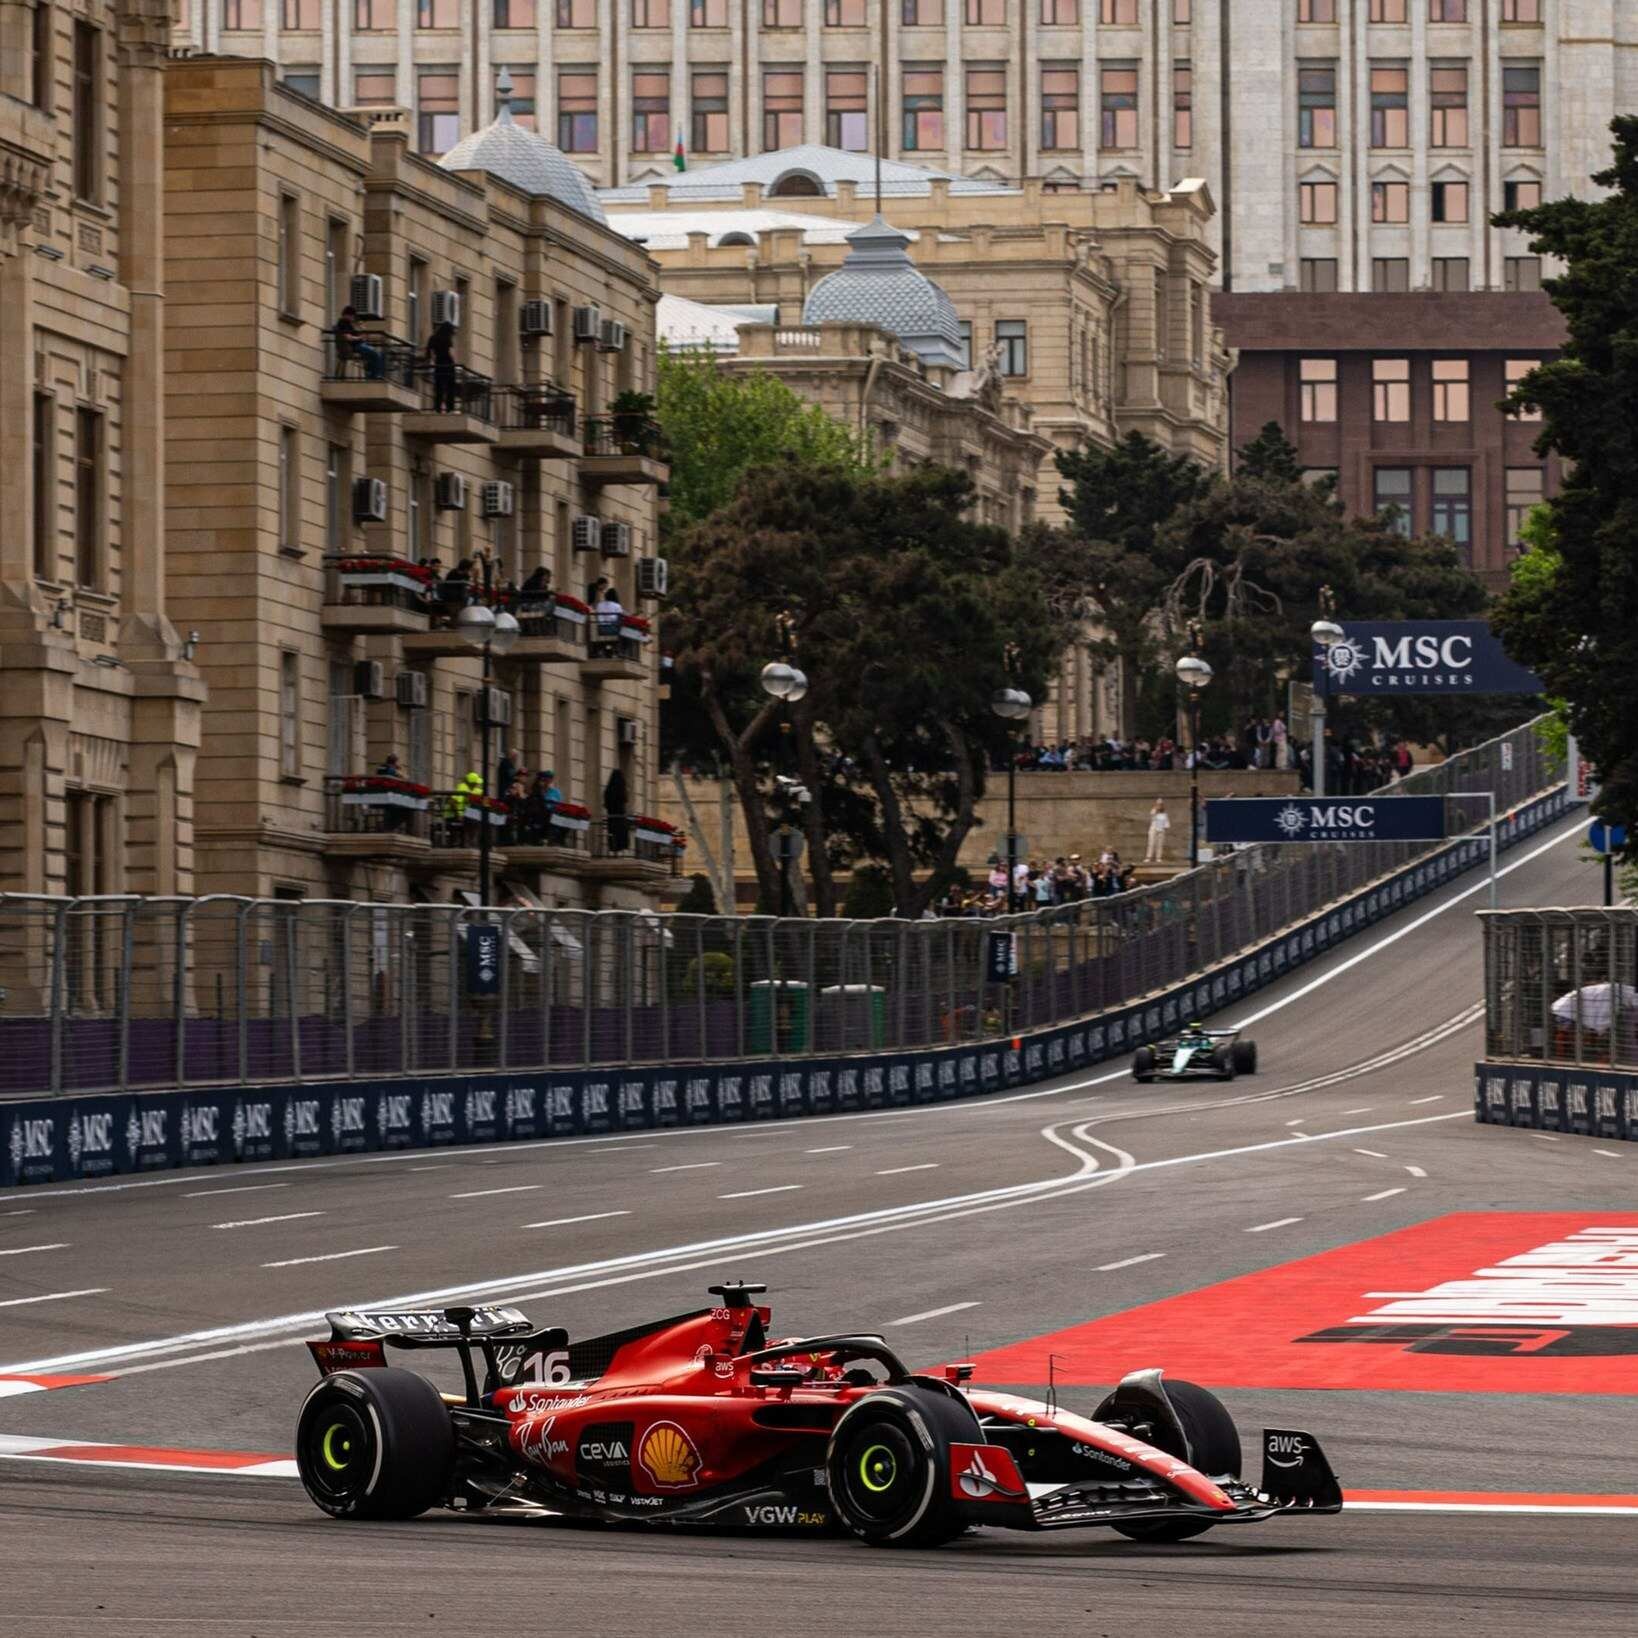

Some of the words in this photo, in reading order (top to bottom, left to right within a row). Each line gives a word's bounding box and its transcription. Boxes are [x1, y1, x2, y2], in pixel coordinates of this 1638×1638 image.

[1372, 636, 1473, 669] MSC
[1371, 675, 1474, 686] CRUISES
[1310, 806, 1375, 828] MSC
[523, 1351, 571, 1387] 16
[715, 1361, 735, 1372] aws
[527, 1394, 592, 1412] Santander
[1269, 1435, 1303, 1454] aws
[1083, 1445, 1131, 1471] Santander
[744, 1506, 798, 1524] VGW
[798, 1512, 826, 1524] PLAY
